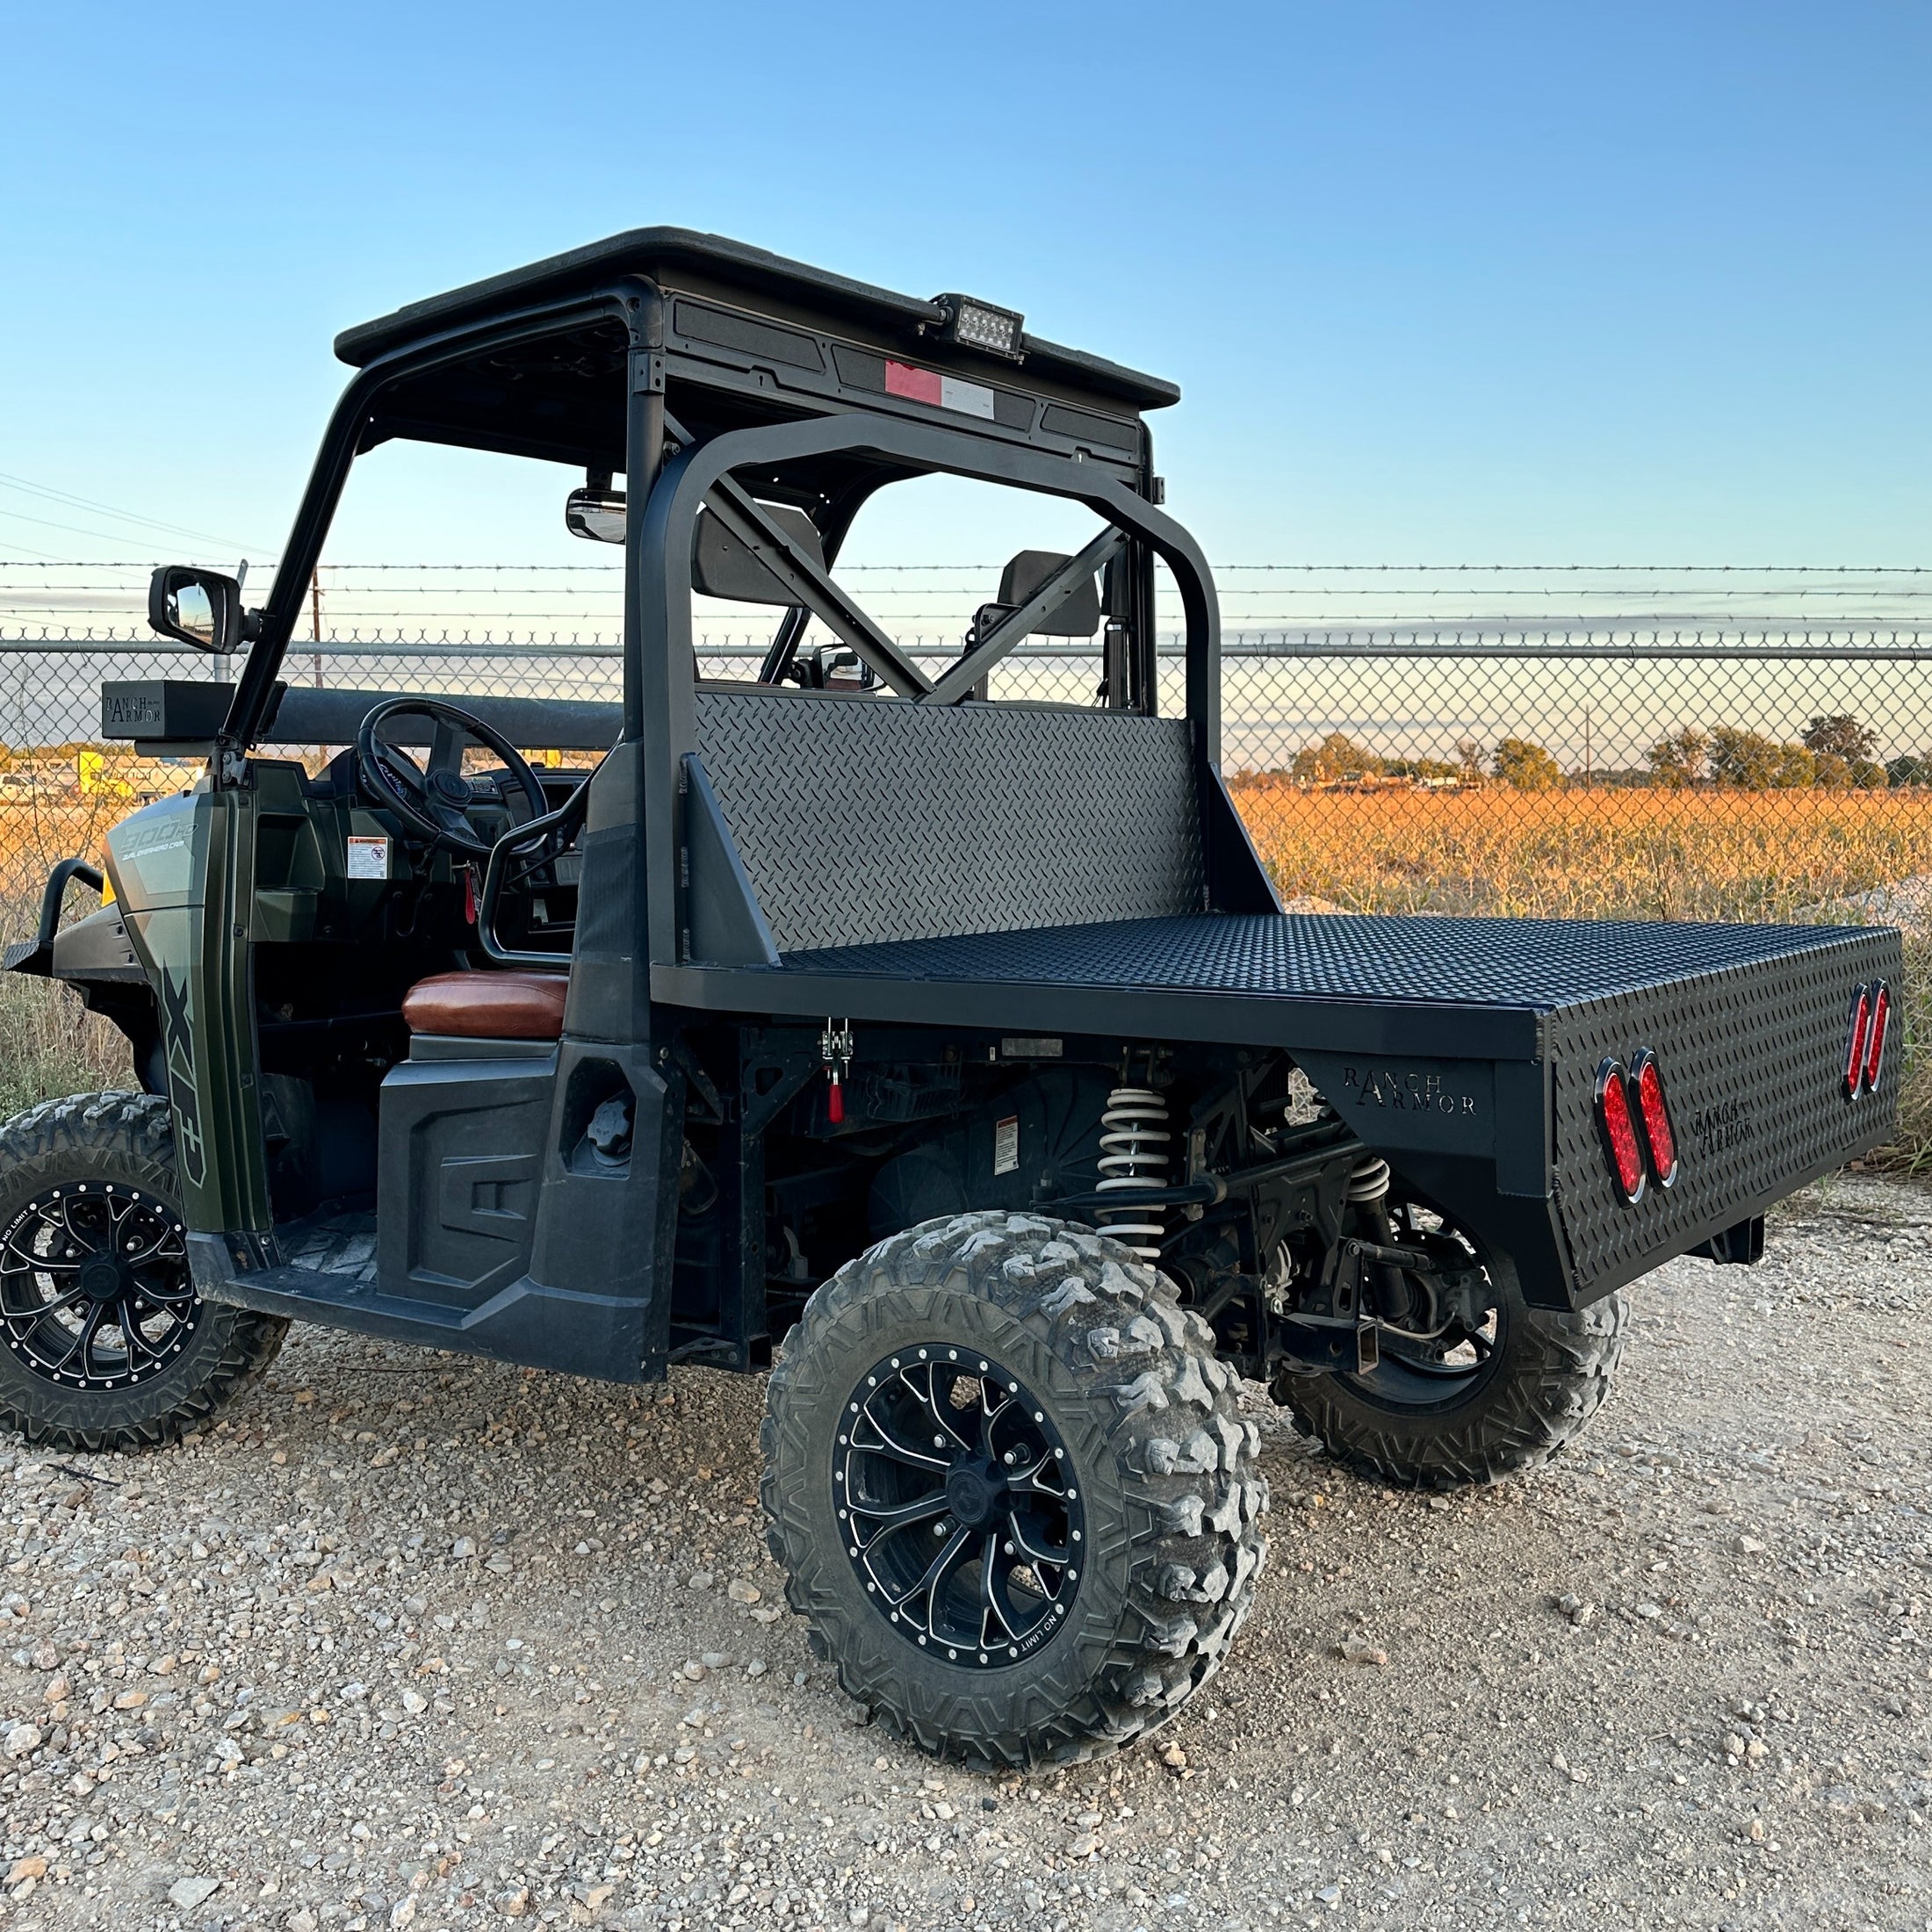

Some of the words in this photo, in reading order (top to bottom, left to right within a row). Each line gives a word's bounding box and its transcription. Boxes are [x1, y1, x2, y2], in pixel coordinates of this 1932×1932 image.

[106, 696, 147, 710] RANCH
[112, 697, 161, 722] ARMOR
[1343, 1067, 1441, 1094] RANCH
[1355, 1070, 1477, 1116] ARMOR
[2, 1229, 12, 1242] NO
[11, 1208, 28, 1229] LIMIT
[1043, 1614, 1057, 1631] NO
[1020, 1629, 1044, 1652] LIMIT
